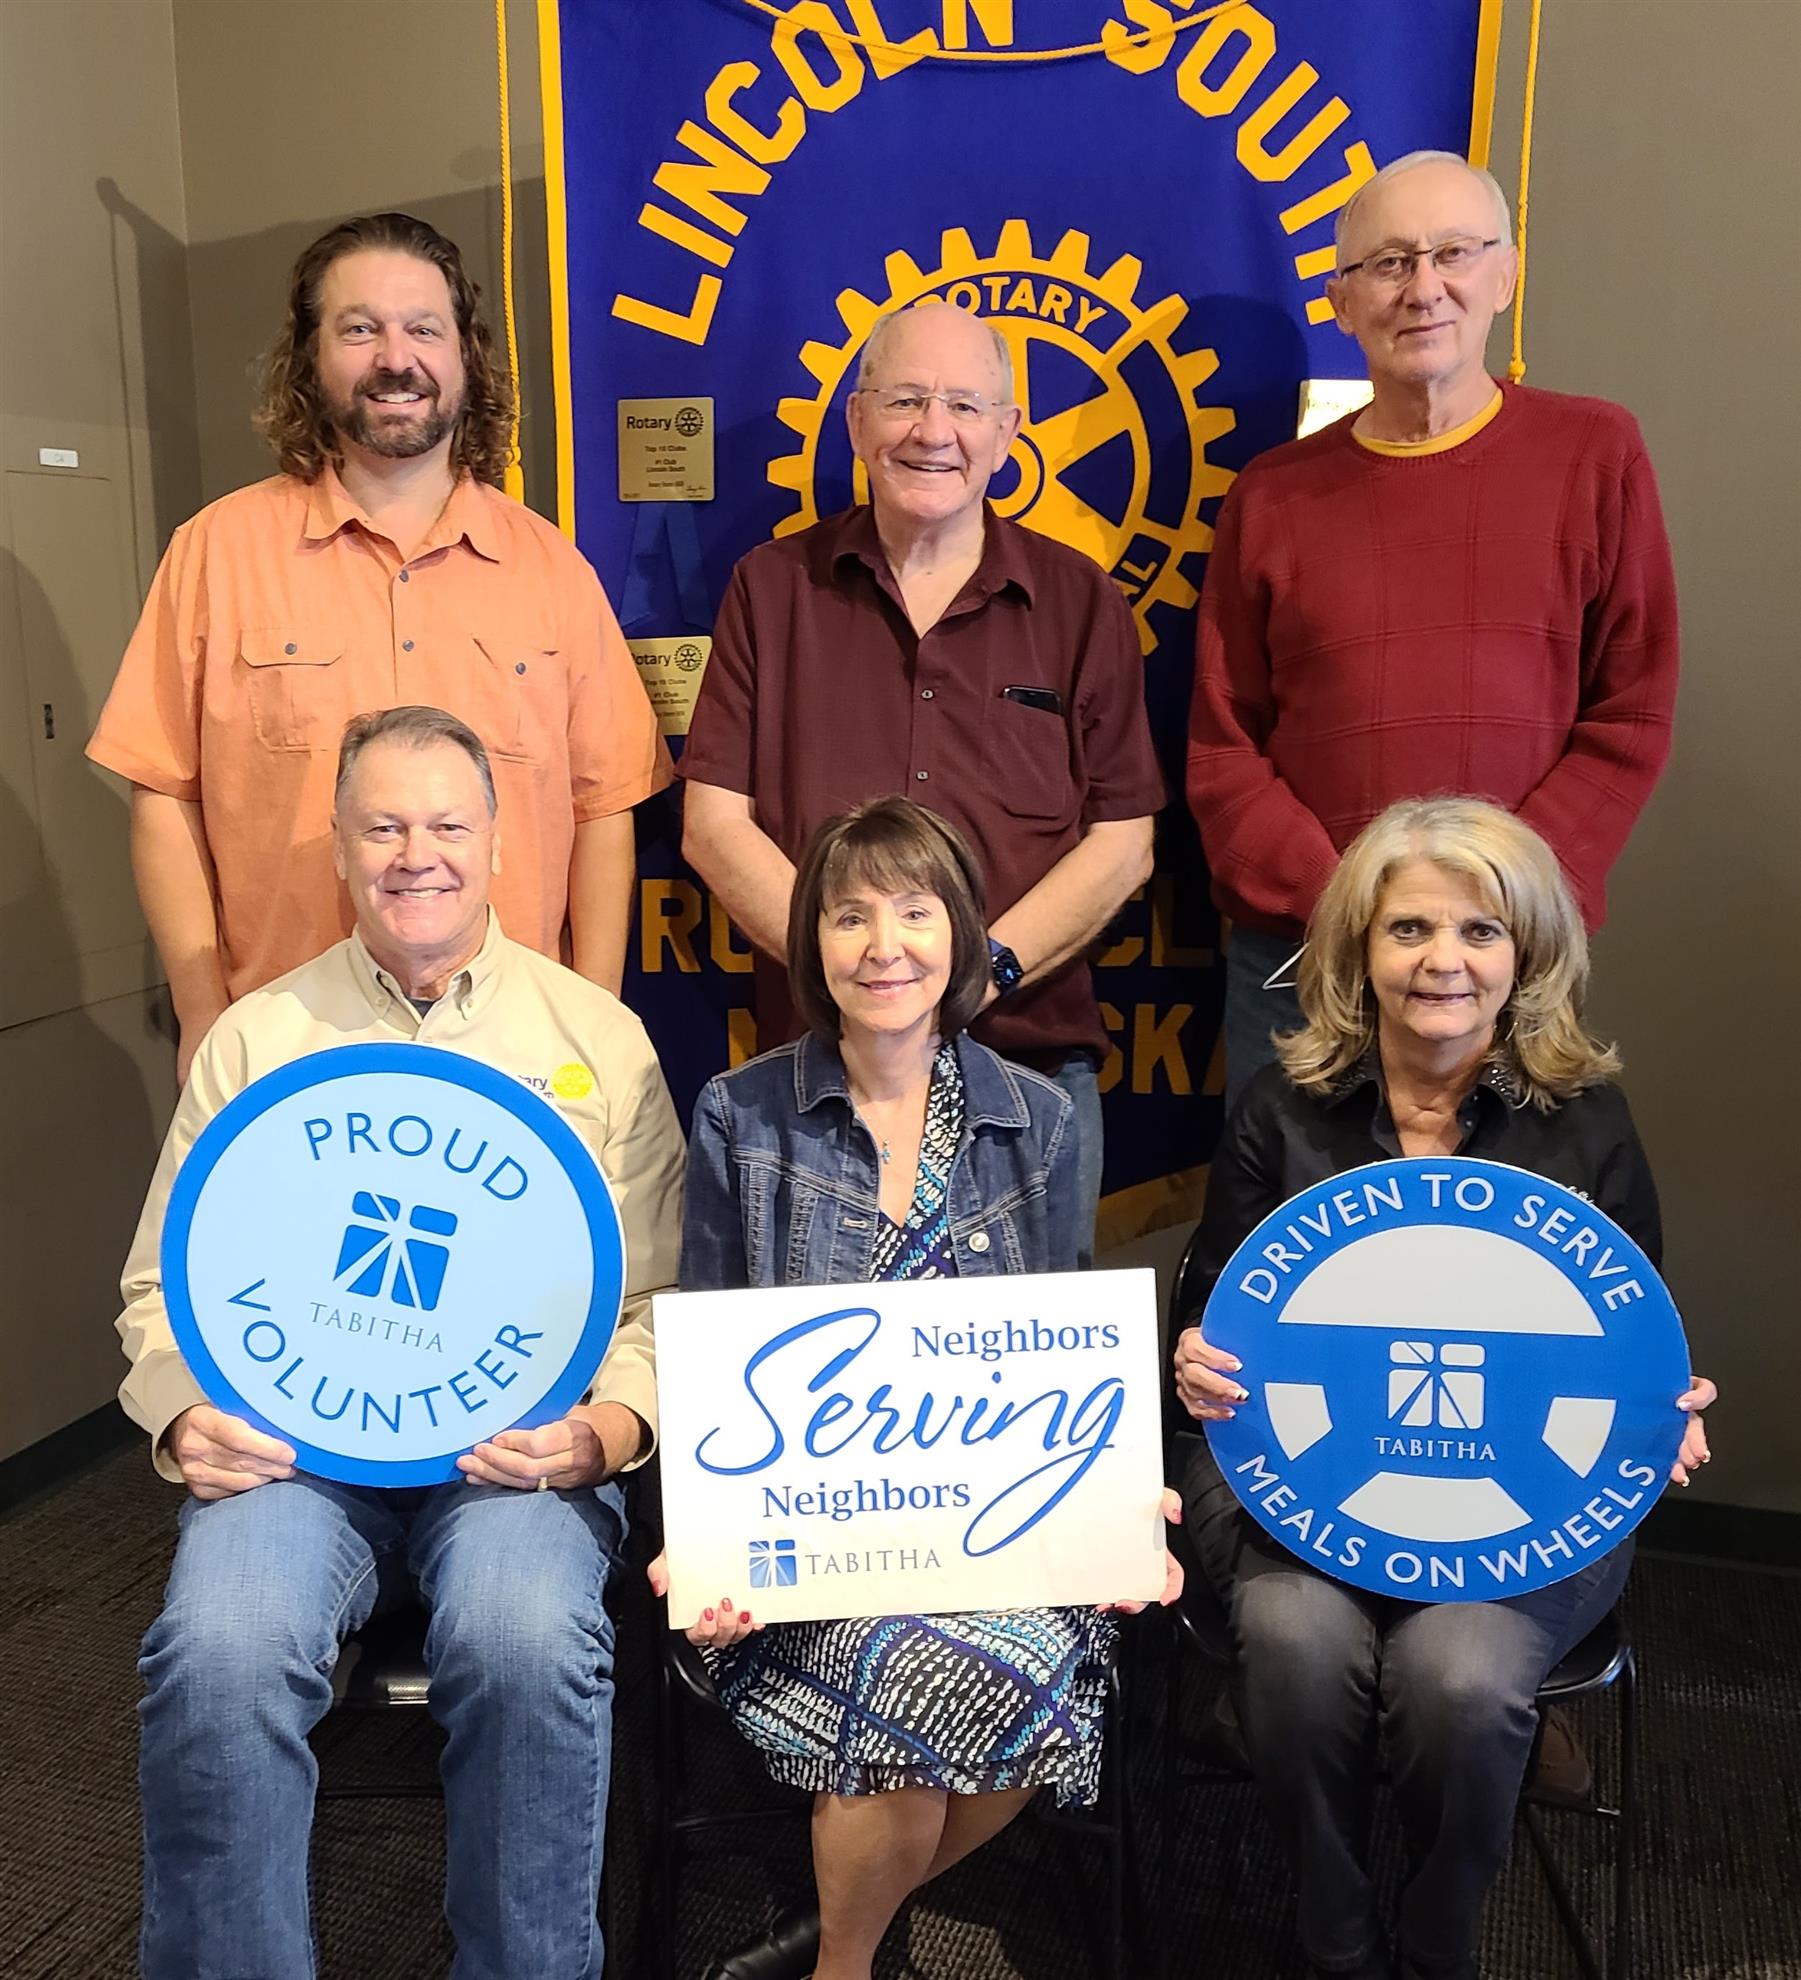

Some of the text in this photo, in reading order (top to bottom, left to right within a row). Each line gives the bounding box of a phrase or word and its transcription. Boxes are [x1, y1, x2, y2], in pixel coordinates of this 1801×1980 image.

[626, 415, 673, 432] Rotary
[631, 653, 671, 667] otary
[303, 1112, 528, 1201] PROUD
[1239, 1173, 1646, 1311] DRIVEN TO SERVE
[309, 1301, 444, 1353] TABITHA
[911, 1318, 1121, 1362] Neighbors
[227, 1278, 544, 1433] VOLUNTEER
[695, 1307, 1125, 1557] Serving
[1374, 1436, 1497, 1461] TABITHA
[762, 1478, 971, 1521] Neighbors
[1234, 1453, 1656, 1588] MEALS ON WHEELS
[804, 1548, 942, 1575] TABITHA
